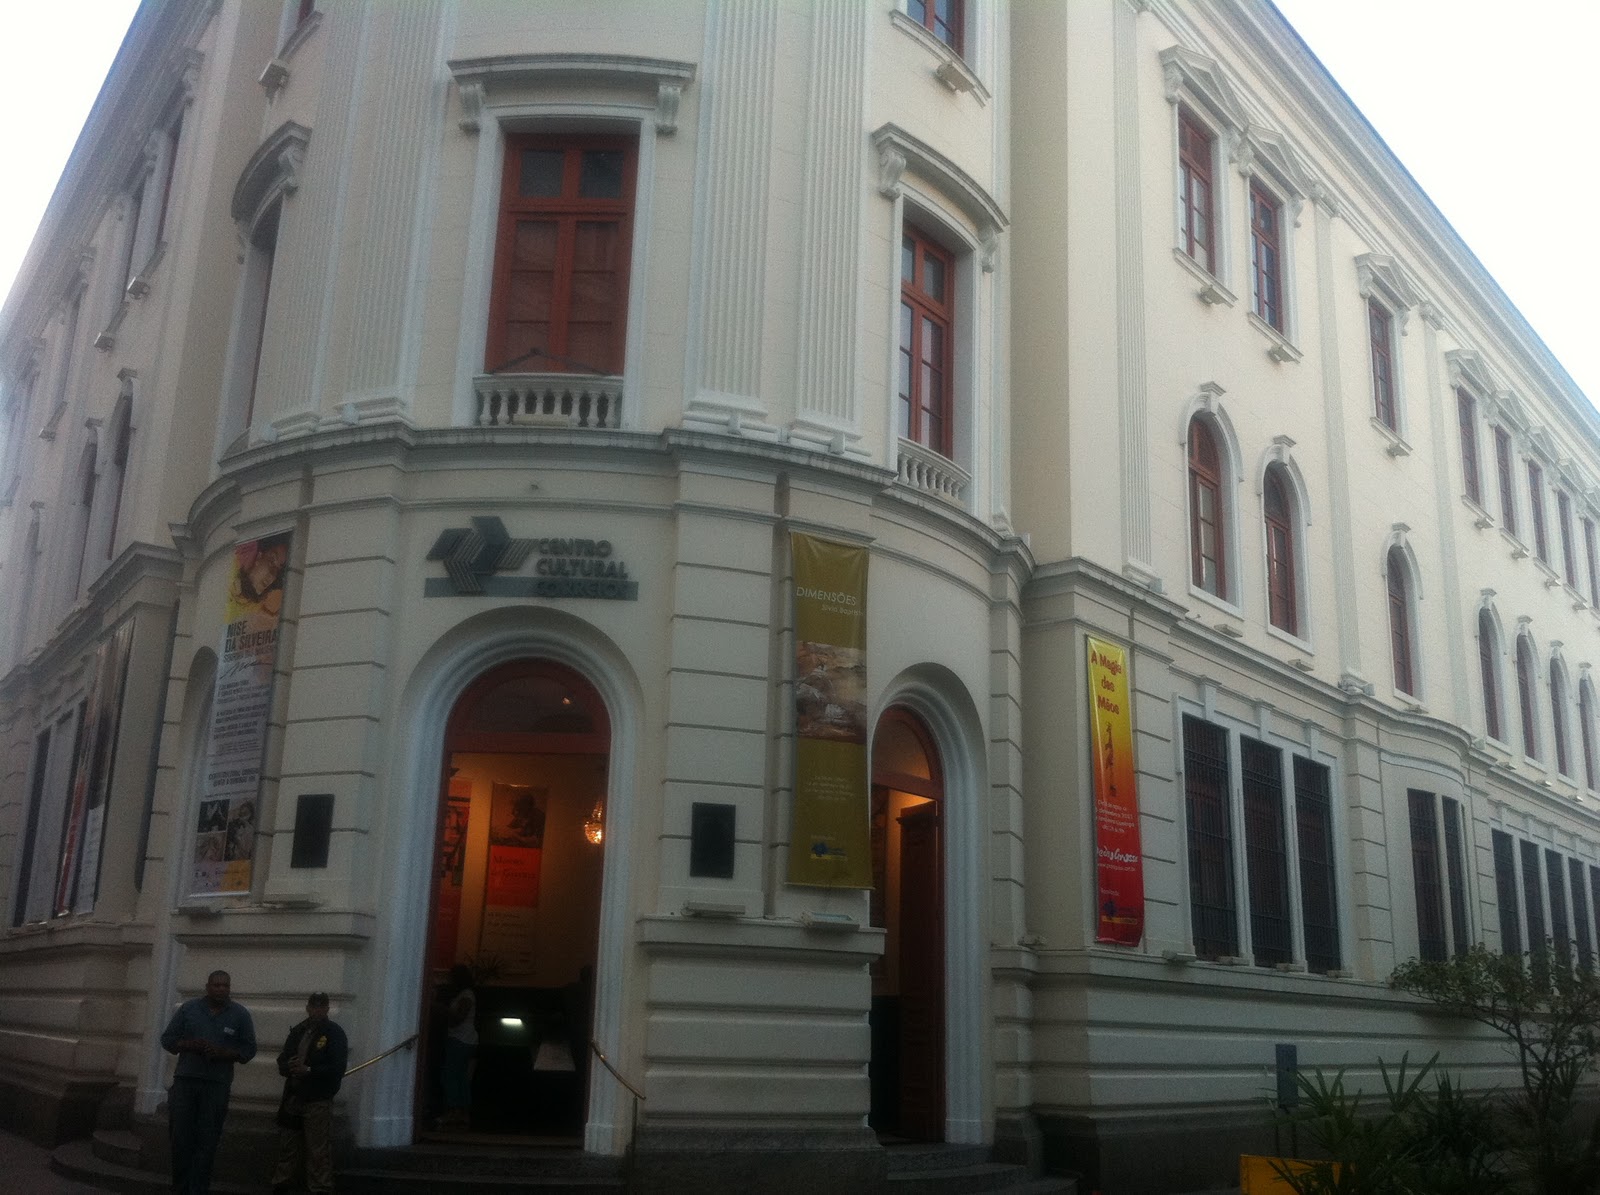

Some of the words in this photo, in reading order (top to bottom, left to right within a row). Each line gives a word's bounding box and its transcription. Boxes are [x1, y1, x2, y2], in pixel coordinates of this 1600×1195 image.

[538, 538, 612, 557] CENTRO
[536, 557, 628, 579] CULTURAL
[227, 620, 248, 638] NISE
[225, 636, 236, 653] DA
[239, 629, 278, 650] SILVEIRA
[1091, 650, 1098, 665] A
